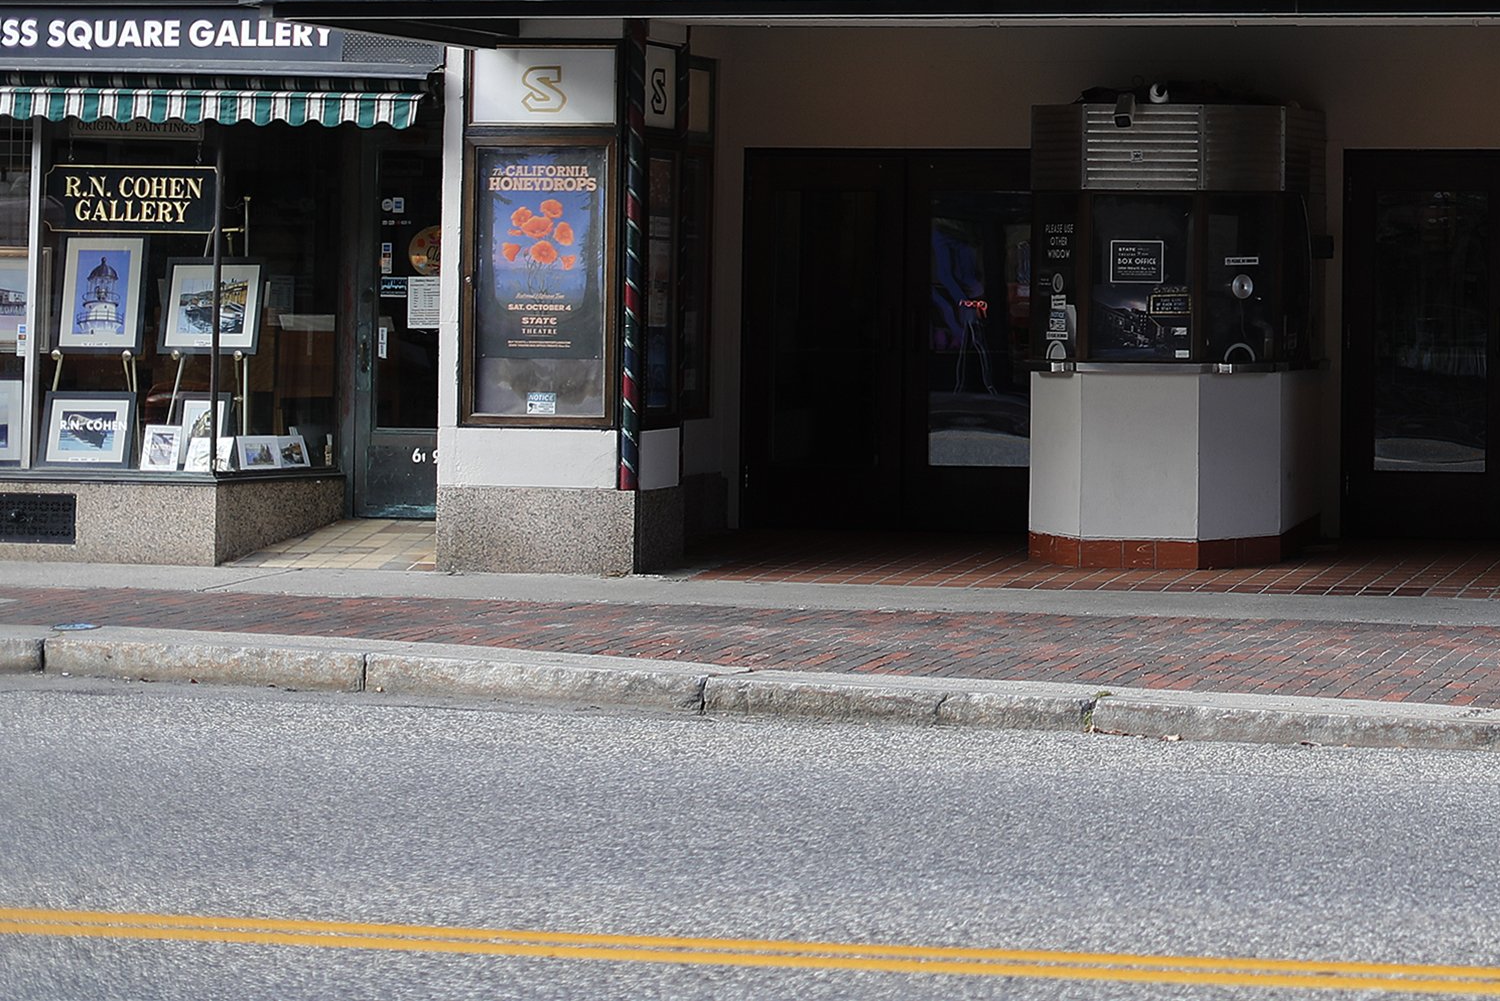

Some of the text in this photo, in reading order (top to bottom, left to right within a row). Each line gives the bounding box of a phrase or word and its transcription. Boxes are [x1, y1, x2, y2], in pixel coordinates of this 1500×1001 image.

[0, 19, 331, 49] SS SQUARE GALLERY
[521, 65, 568, 113] S
[651, 68, 667, 115] S
[77, 117, 197, 133] ORIGINAL PAINTINGS
[505, 165, 589, 177] CALIFORNIA
[65, 176, 204, 199] R.N. COHEN
[489, 177, 597, 191] HONEYDROPS
[75, 200, 190, 224] GALLERY
[507, 303, 572, 311] SAT. OCTOBER 4
[521, 316, 557, 325] STATE
[60, 418, 128, 431] R.N. COHEN
